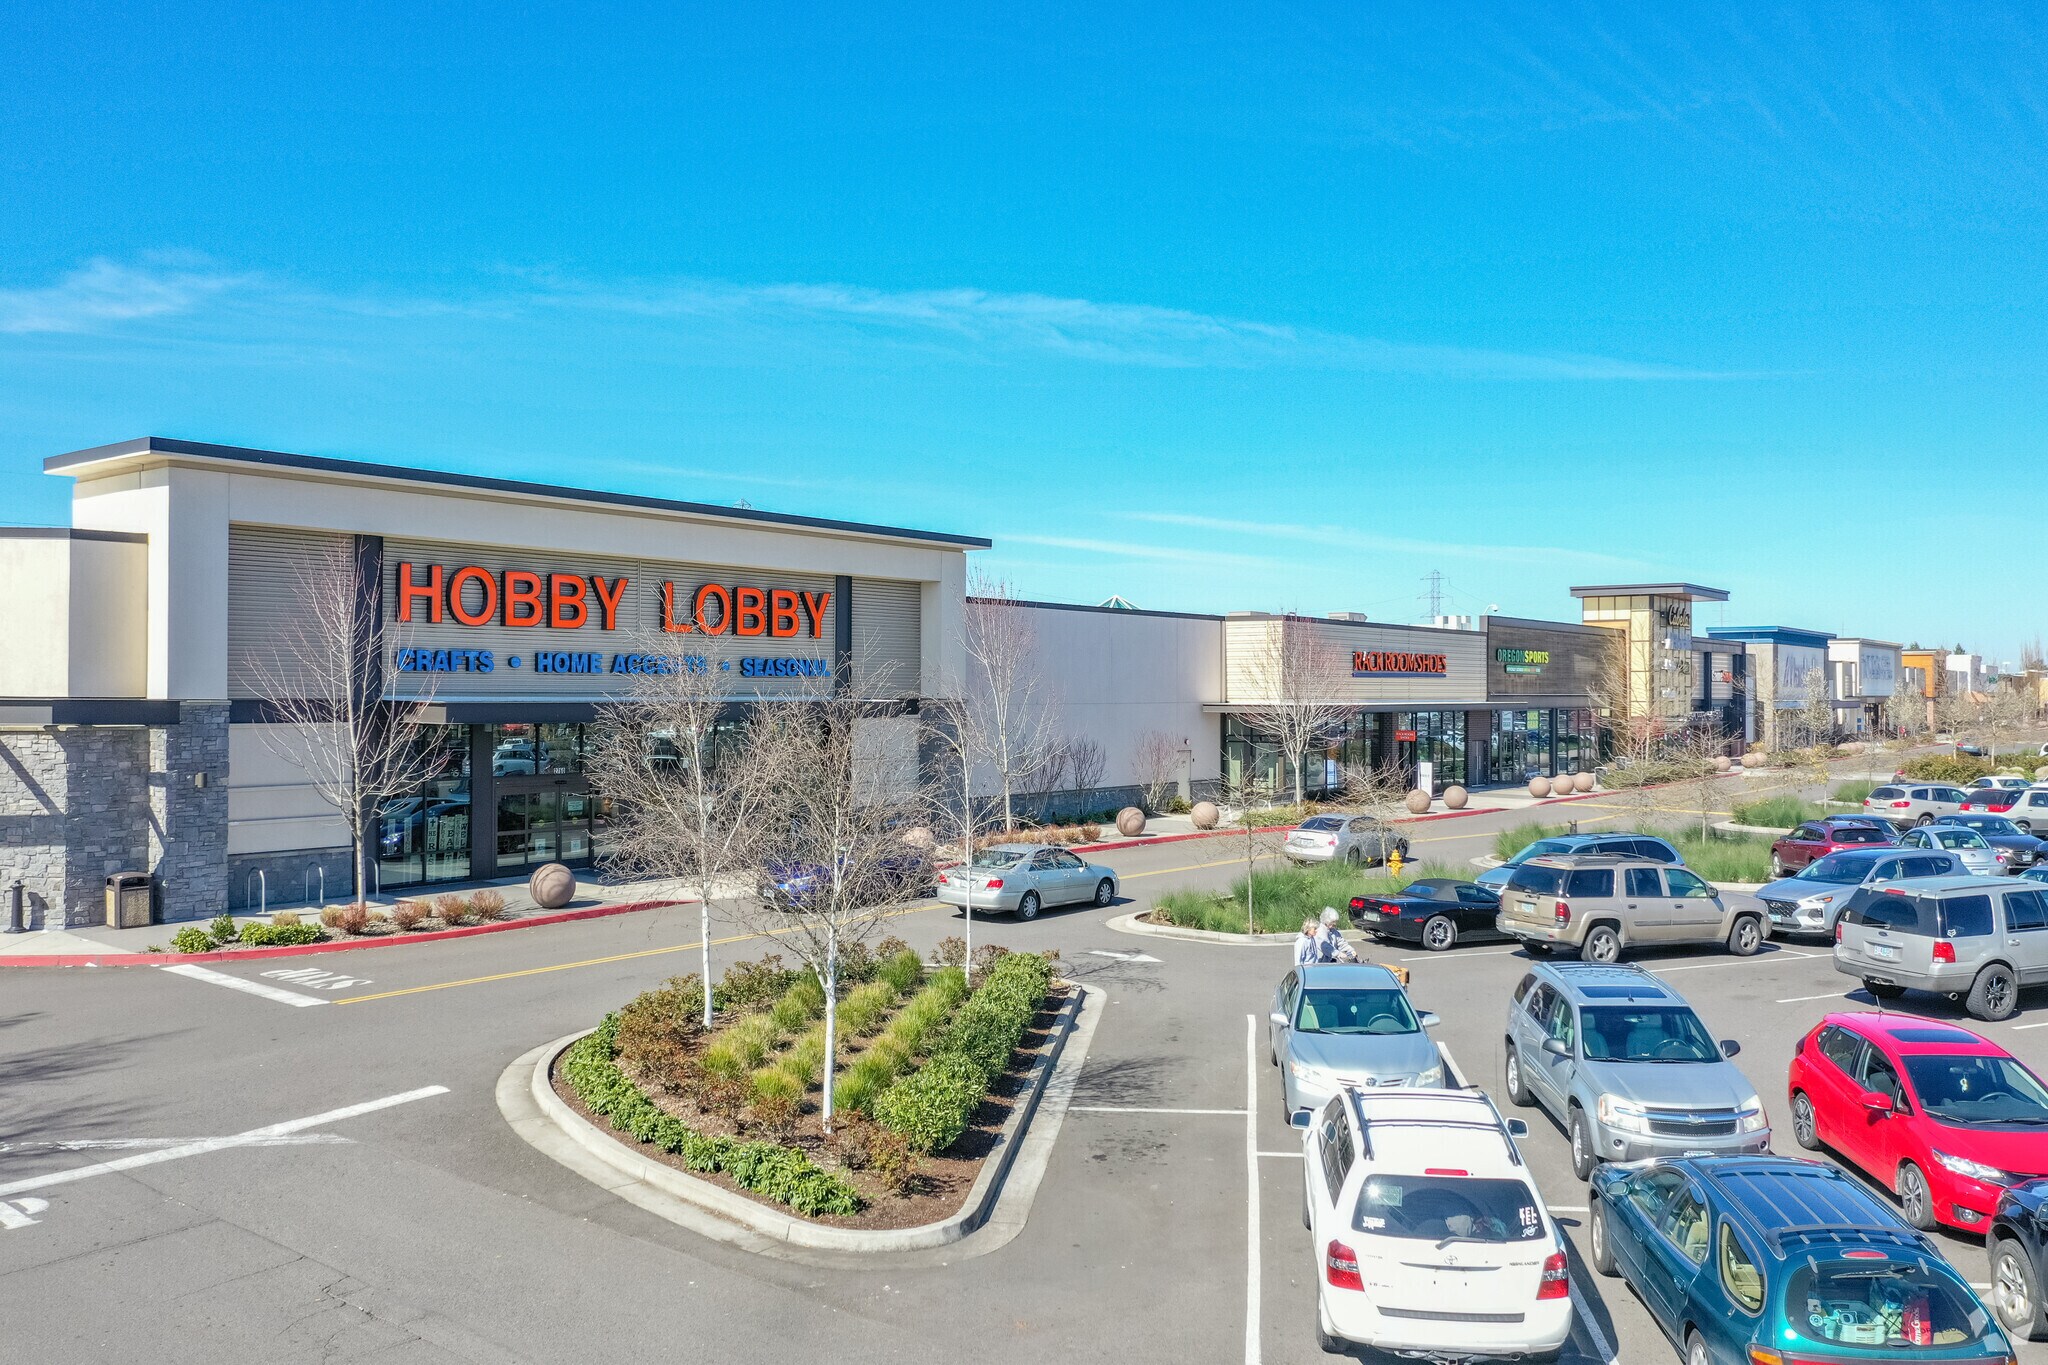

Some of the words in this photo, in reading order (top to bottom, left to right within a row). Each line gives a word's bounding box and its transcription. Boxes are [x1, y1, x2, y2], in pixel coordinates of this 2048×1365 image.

[396, 562, 629, 630] HOBBY
[659, 580, 831, 639] LOBBY
[396, 649, 495, 673] CRAFTS
[534, 652, 603, 674] HOME
[740, 657, 831, 677] SEASONAL
[1353, 651, 1383, 671] RACK
[1385, 652, 1417, 672] ROOM
[1417, 654, 1447, 673] SHOES
[1496, 648, 1525, 663] OREGON
[1524, 649, 1549, 664] SPORTS
[1519, 1206, 1536, 1219] KEL
[1520, 1214, 1538, 1226] TEC
